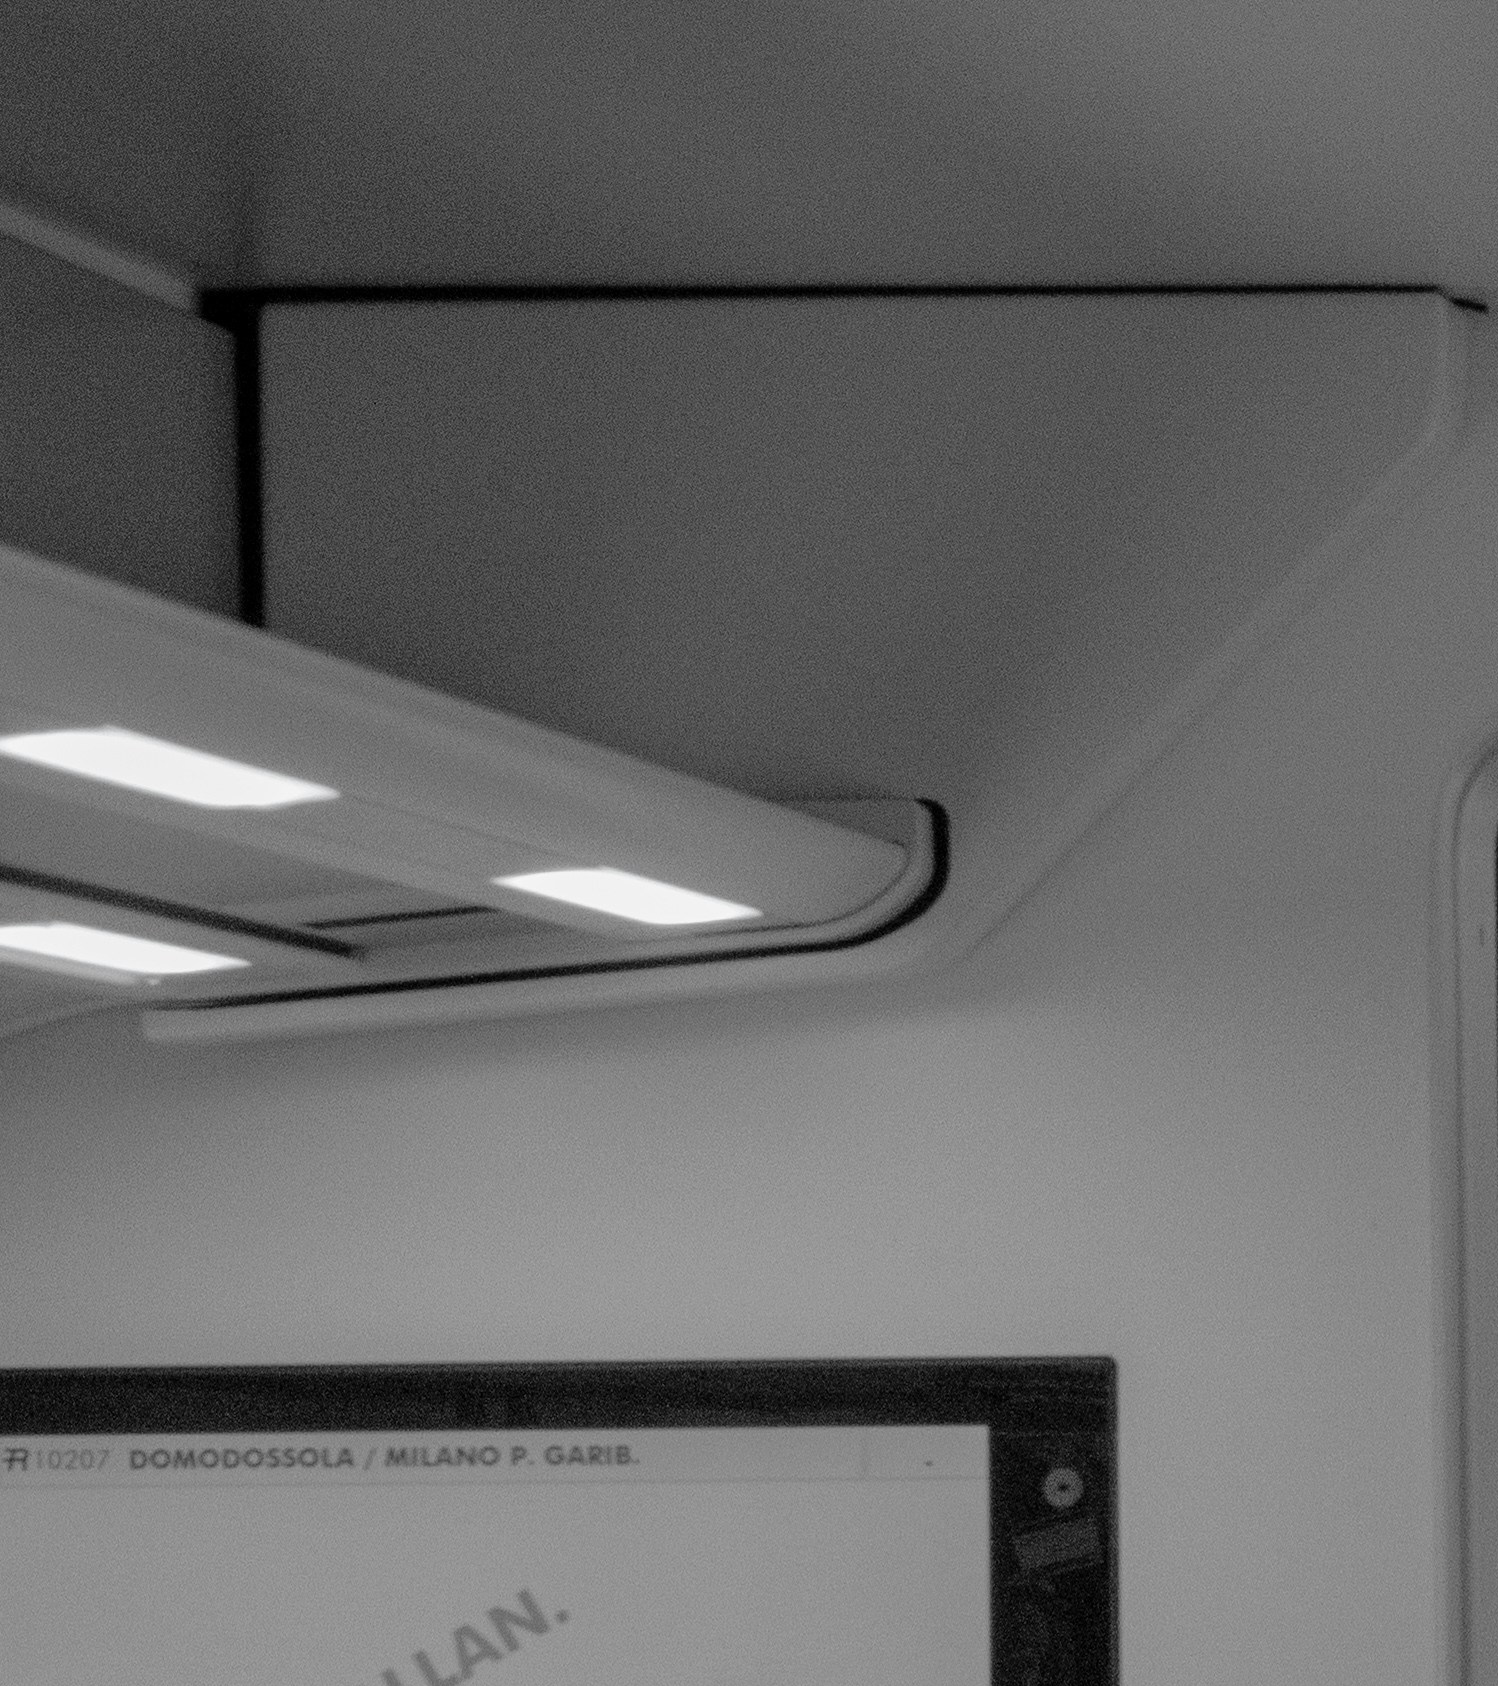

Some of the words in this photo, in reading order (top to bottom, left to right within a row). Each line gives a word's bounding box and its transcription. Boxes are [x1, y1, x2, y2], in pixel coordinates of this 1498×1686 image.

[129, 1446, 354, 1470] DOMODOSSOLA
[384, 1445, 501, 1467] MILANO
[511, 1444, 535, 1466] P.
[544, 1444, 640, 1466] GARIB.
